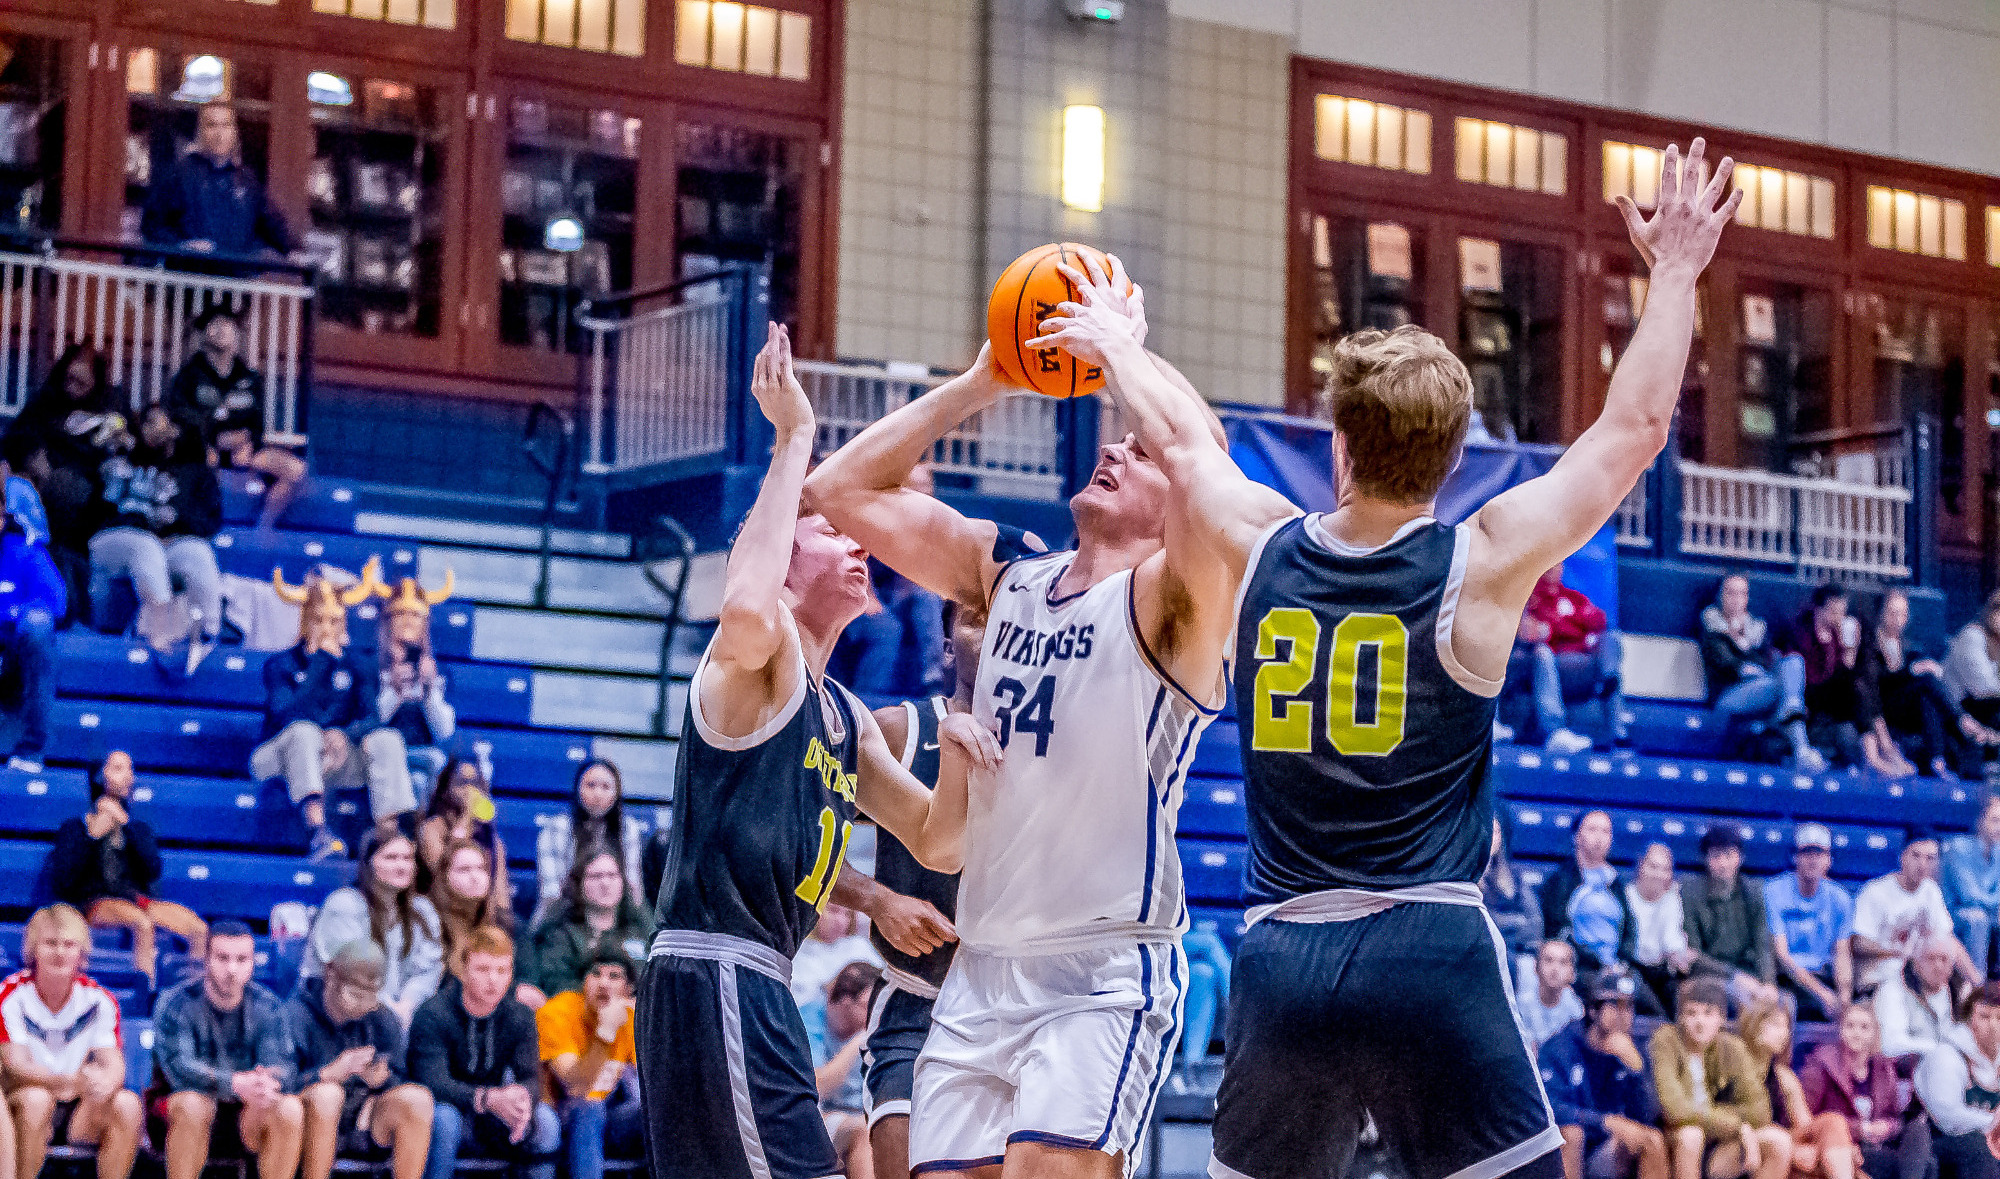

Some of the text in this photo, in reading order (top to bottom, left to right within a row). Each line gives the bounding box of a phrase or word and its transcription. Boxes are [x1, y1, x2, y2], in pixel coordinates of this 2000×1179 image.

[991, 621, 1095, 667] VIKINGS
[1252, 607, 1409, 757] 20
[993, 675, 1056, 758] 34
